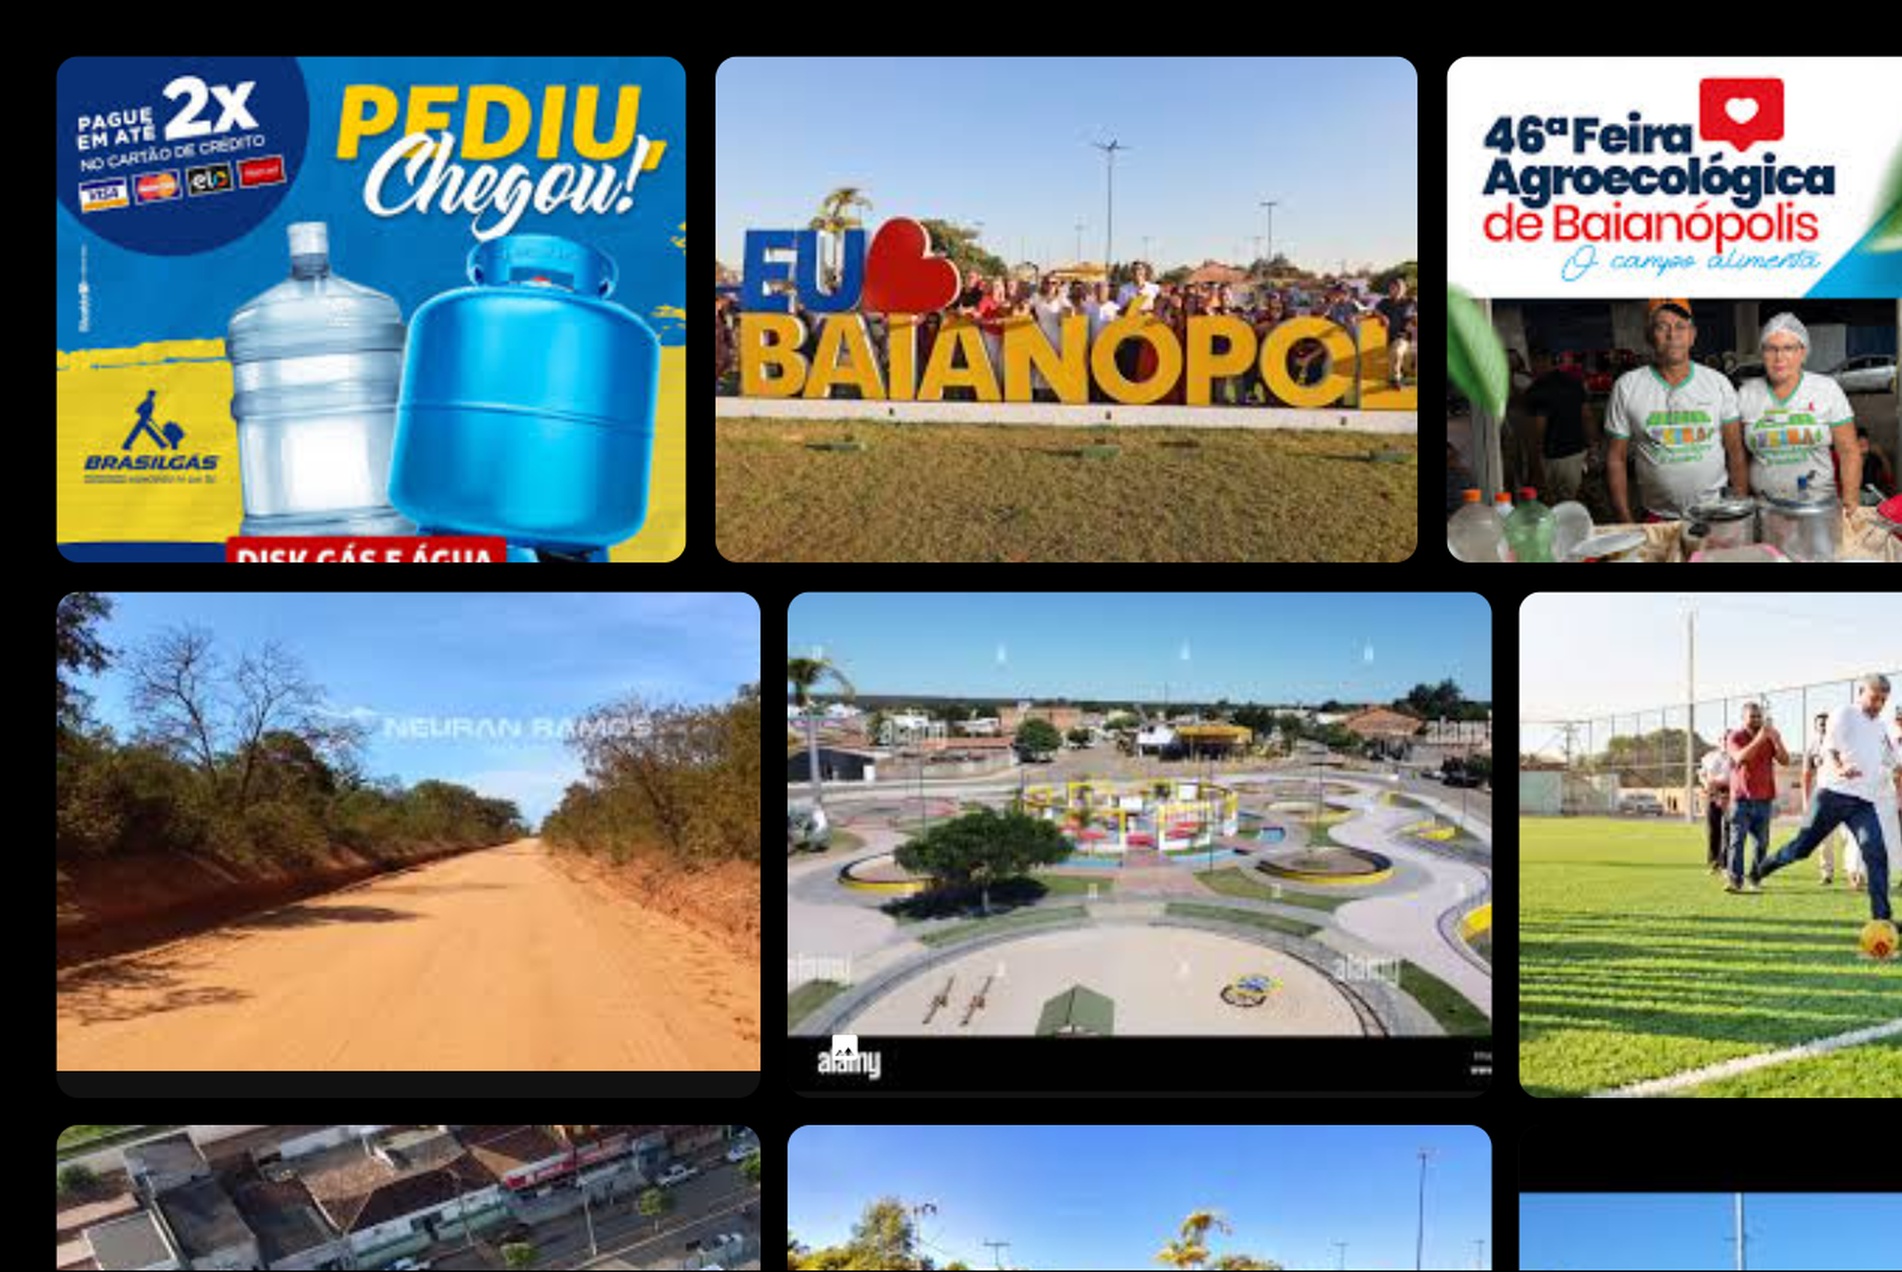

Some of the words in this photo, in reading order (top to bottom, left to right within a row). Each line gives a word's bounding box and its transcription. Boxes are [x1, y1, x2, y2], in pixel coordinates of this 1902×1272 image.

[78, 106, 153, 133] PAGUE
[78, 133, 108, 150] EM
[336, 84, 667, 171] PEDIU,
[1572, 111, 1693, 155] Feira
[80, 158, 104, 172] NO
[107, 146, 172, 168] CARTÃO
[174, 143, 196, 159] DE
[191, 170, 228, 191] elo
[363, 130, 651, 242] Chegou!
[1482, 152, 1836, 209] Agroecológica
[1483, 202, 1543, 242] de
[1553, 201, 1819, 254] Baianópolis
[742, 230, 866, 313] EU
[1561, 244, 1600, 282] O
[1609, 253, 1697, 277] campo
[1707, 247, 1823, 271] alimenta
